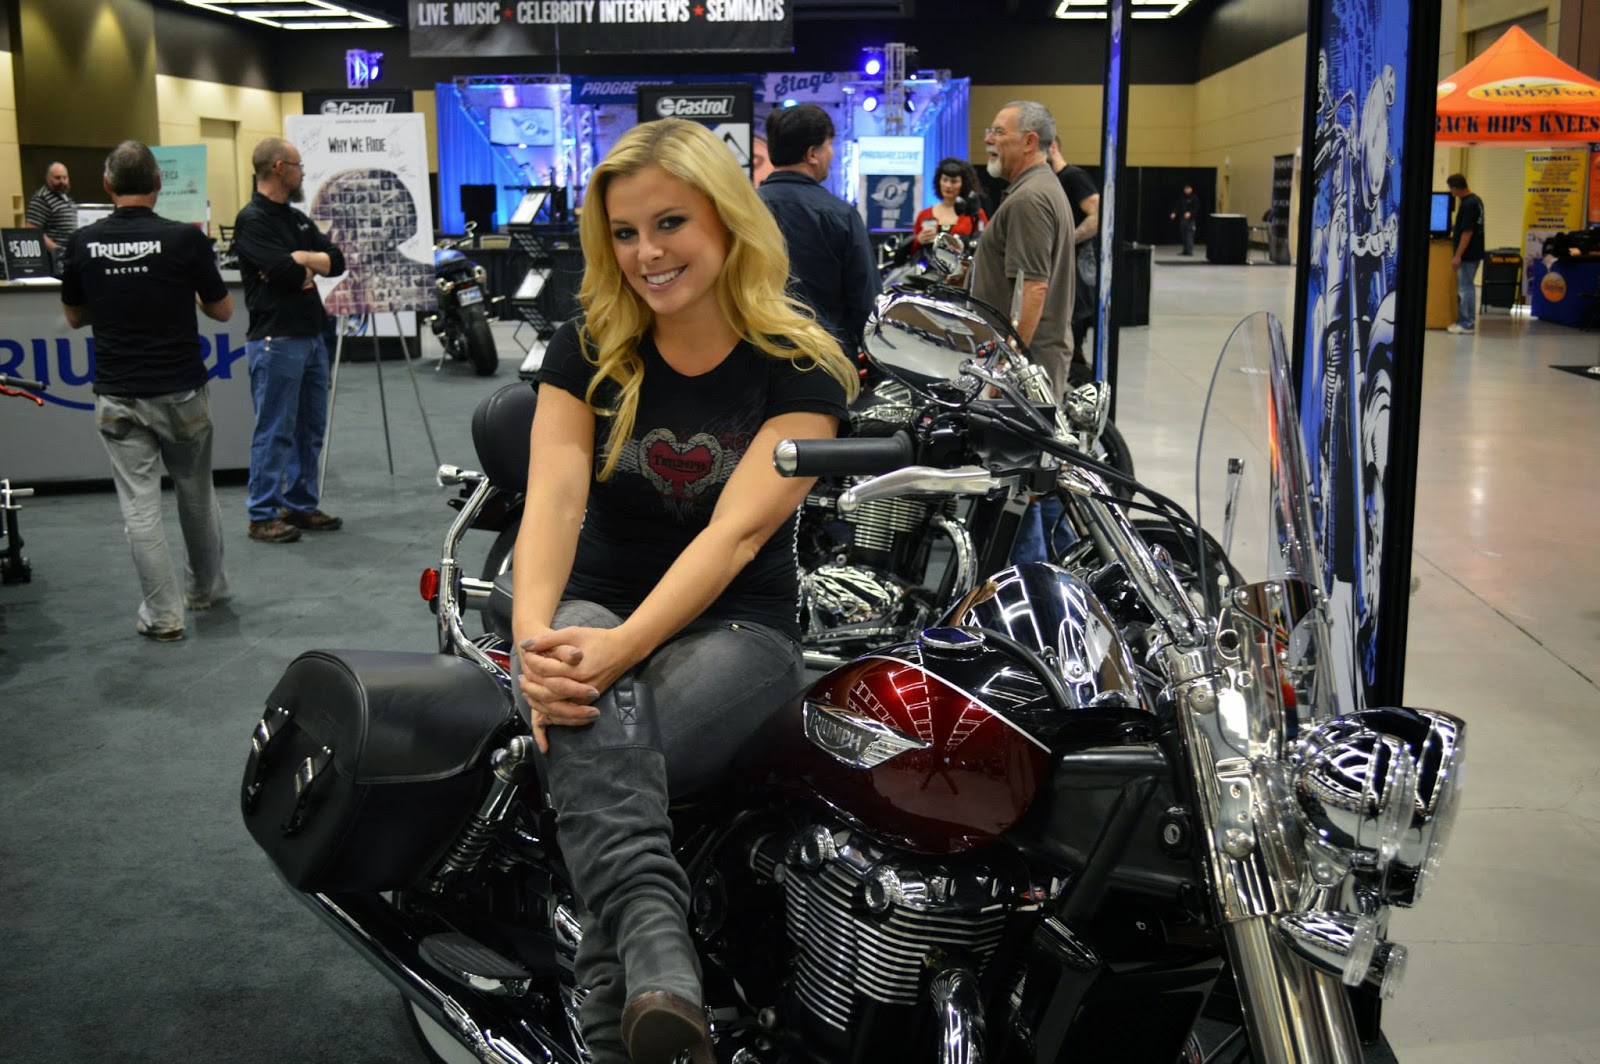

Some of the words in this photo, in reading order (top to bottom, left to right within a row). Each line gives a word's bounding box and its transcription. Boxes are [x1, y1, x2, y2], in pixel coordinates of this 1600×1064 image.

[418, 3, 449, 26] LIVE
[453, 2, 500, 25] MUSIC
[516, 0, 595, 24] CELEBRITY
[599, 0, 690, 23] INTERVIEWS
[706, 0, 785, 22] SEMINARS
[774, 71, 836, 99] Stage
[339, 101, 389, 115] Castrol
[674, 99, 728, 115] Castrol
[1487, 115, 1532, 133] HIPS
[1539, 114, 1600, 133] KNEES
[328, 138, 348, 154] WHY
[350, 137, 364, 153] WE
[366, 136, 387, 152] RIDE
[87, 240, 162, 261] TRIUMPH
[105, 266, 148, 275] RACING
